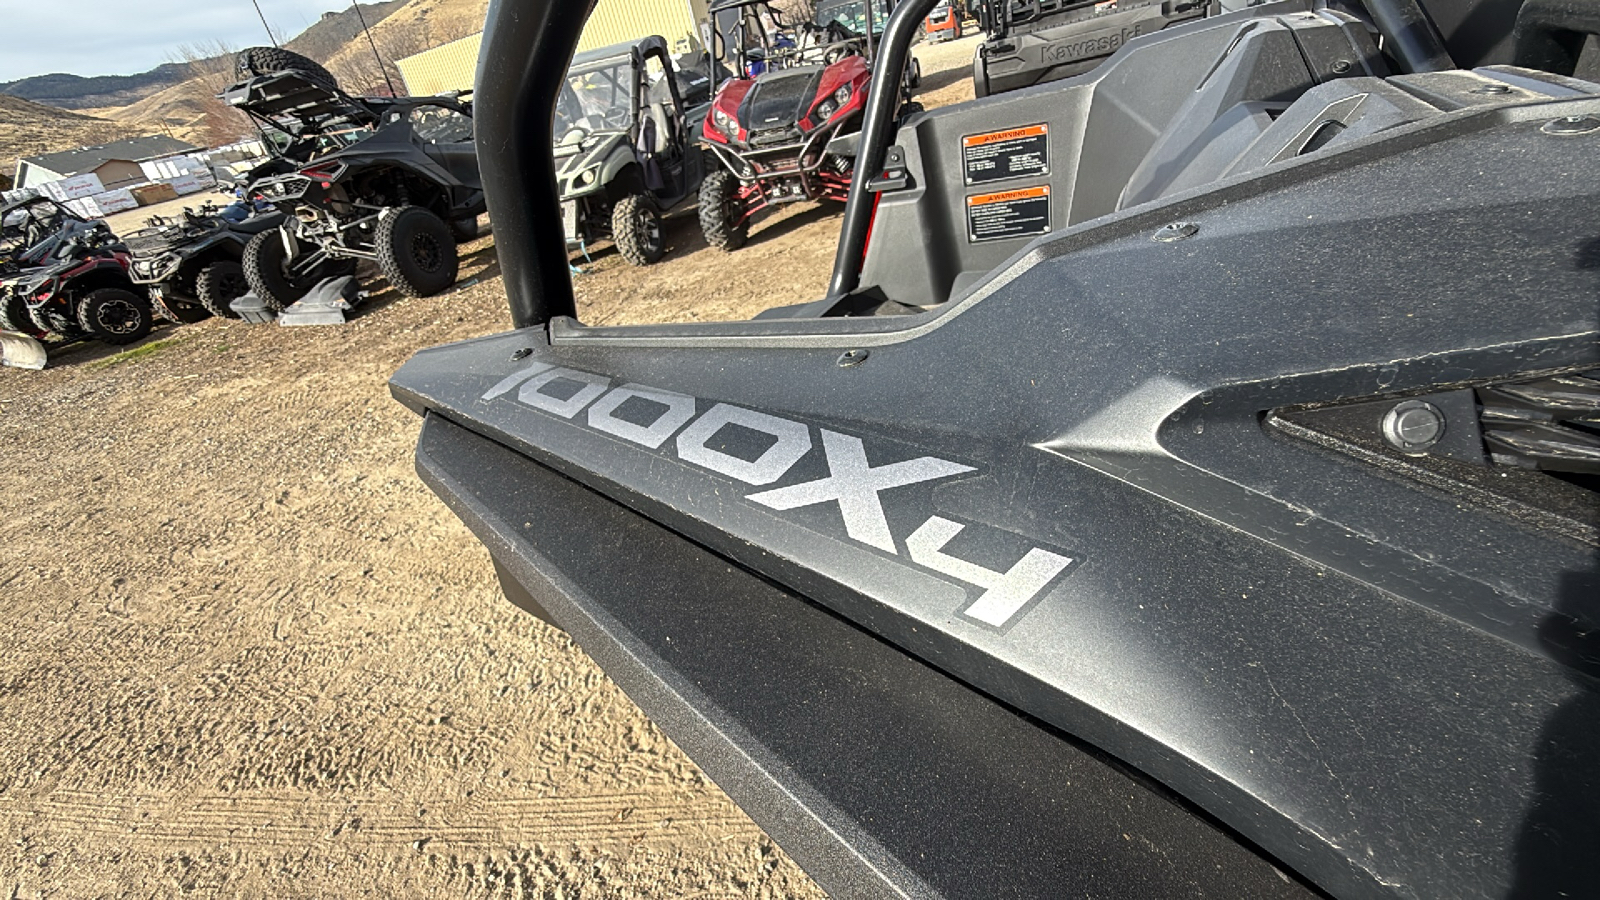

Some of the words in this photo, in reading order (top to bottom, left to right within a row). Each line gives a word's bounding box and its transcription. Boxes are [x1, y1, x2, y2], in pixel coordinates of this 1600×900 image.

[990, 129, 1026, 142] WARNING
[993, 190, 1029, 202] WARNING
[481, 362, 1073, 627] 1000X4
